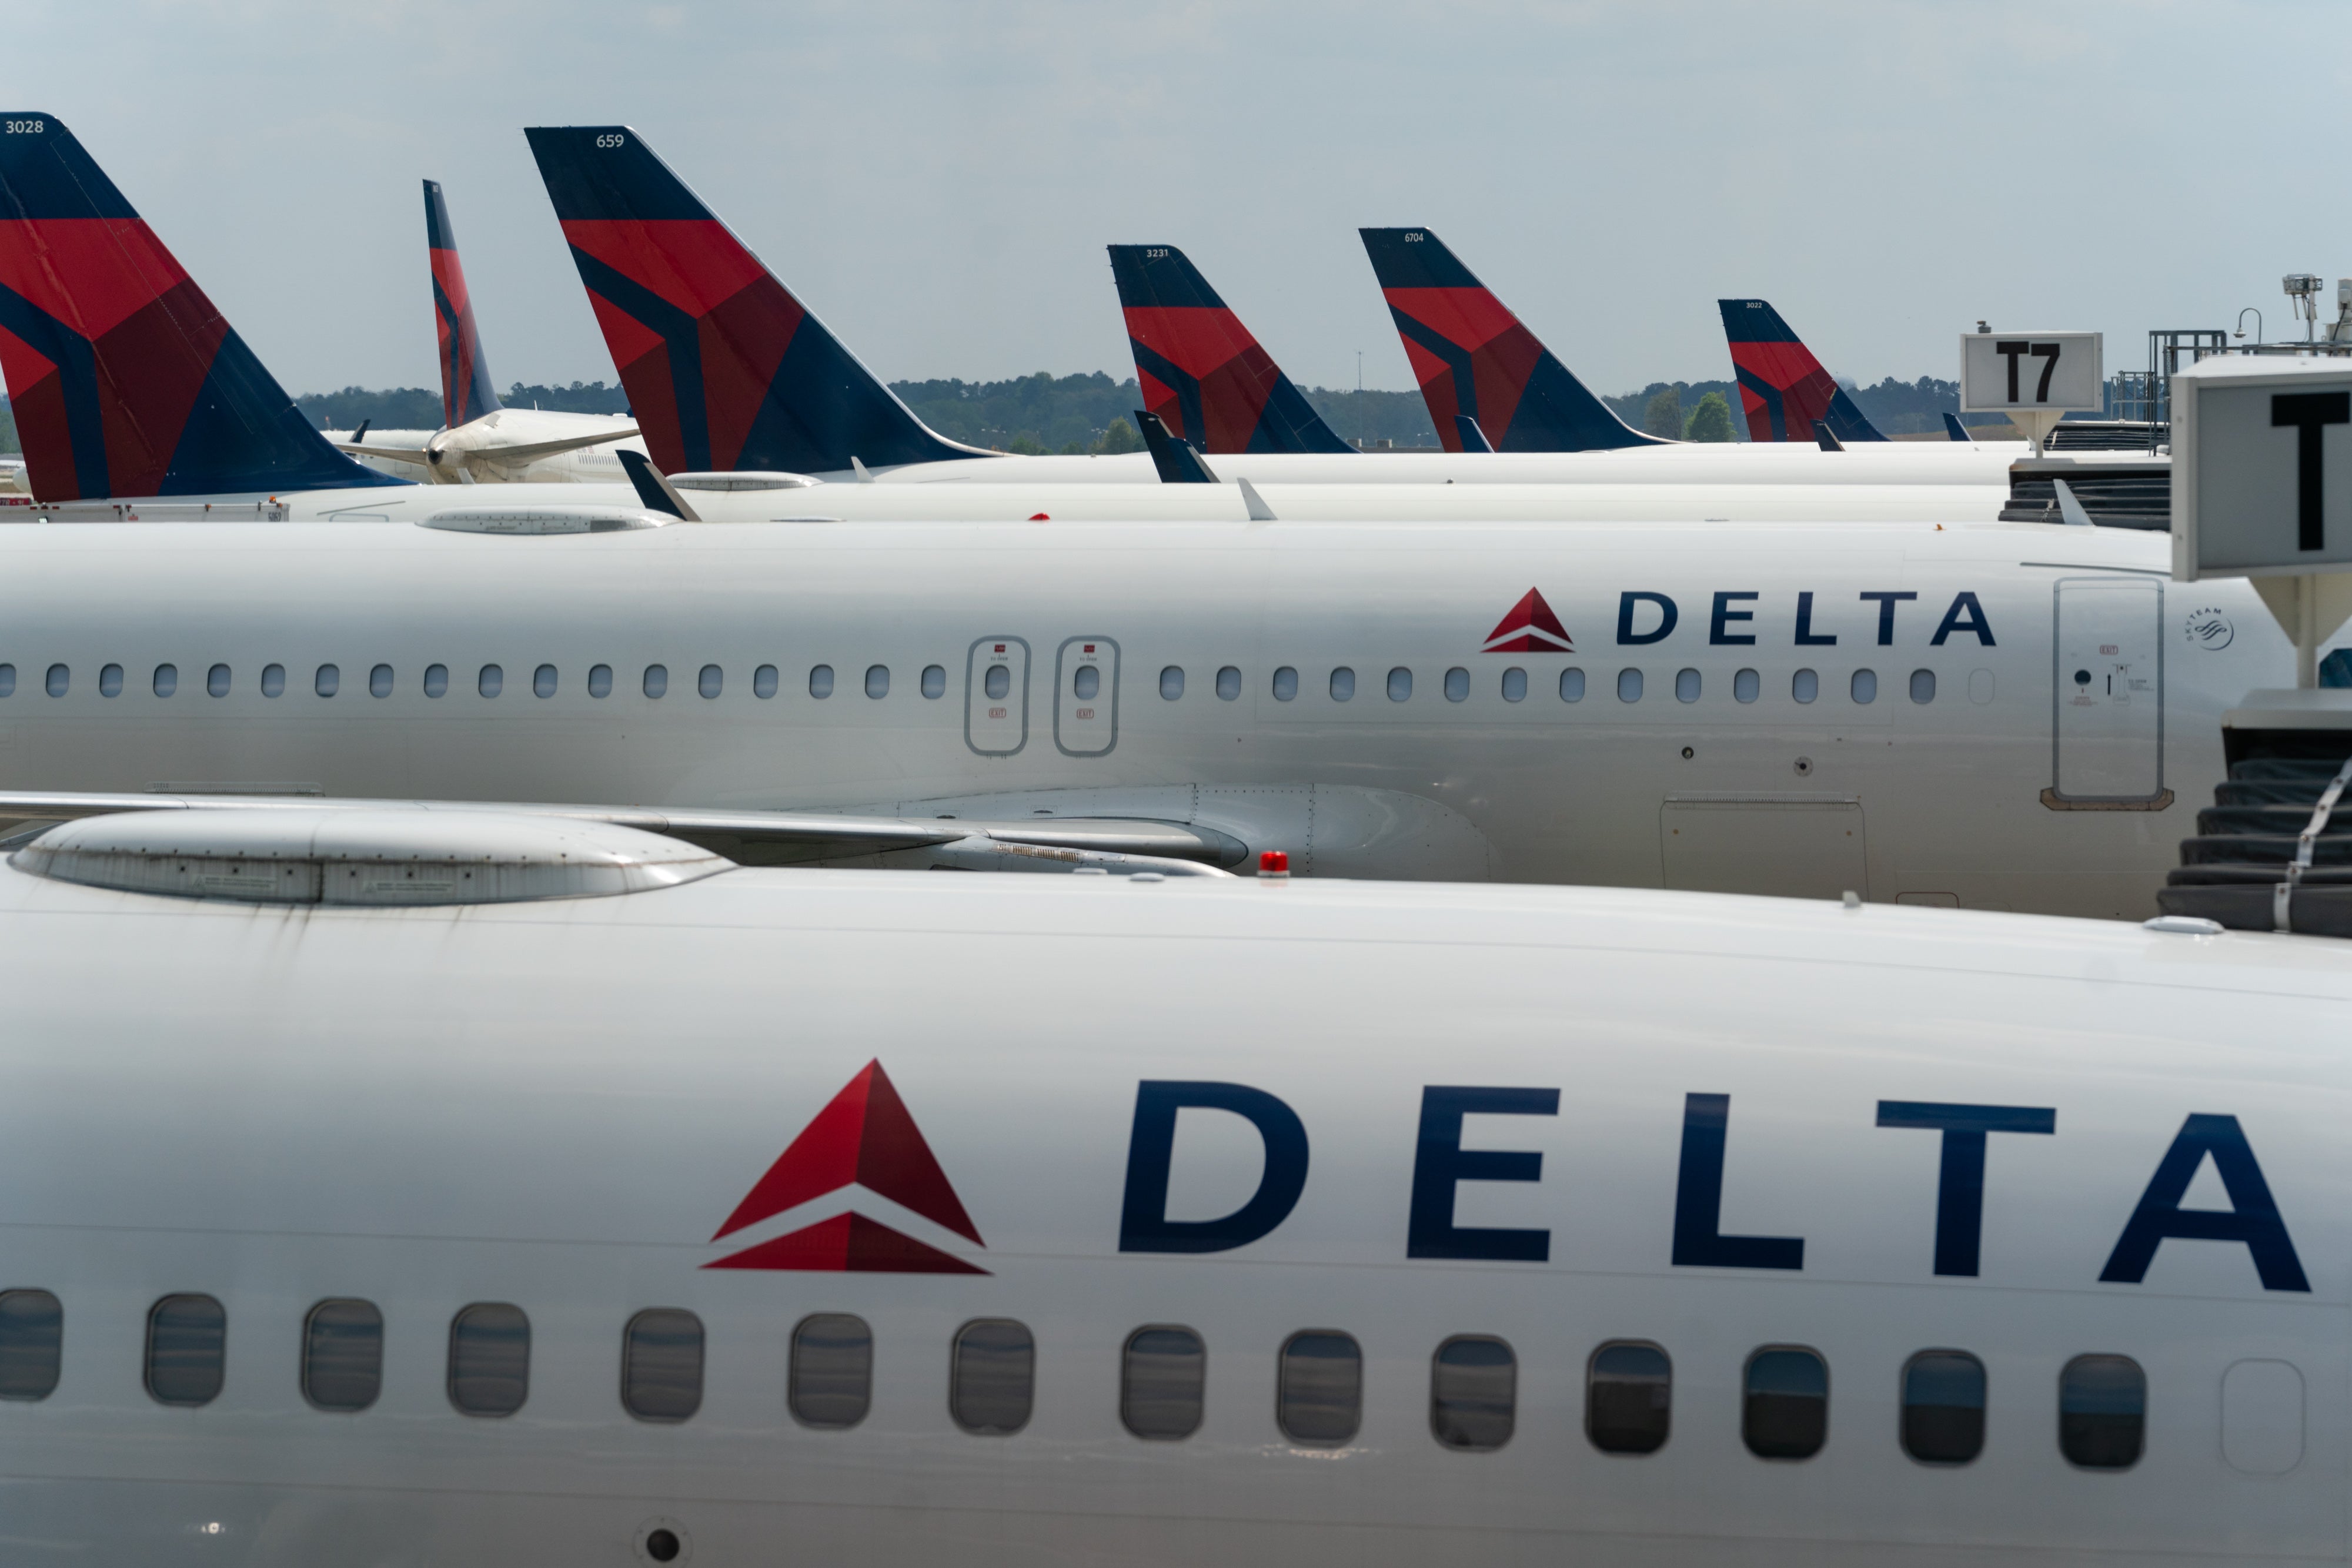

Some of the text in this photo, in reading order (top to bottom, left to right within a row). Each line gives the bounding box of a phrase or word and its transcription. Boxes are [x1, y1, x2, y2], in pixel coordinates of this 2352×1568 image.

[6, 120, 44, 133] 3028
[596, 134, 624, 148] 659
[1405, 232, 1424, 242] 6704
[1147, 249, 1168, 258] 3231
[1996, 341, 2060, 403] T7
[1616, 591, 1997, 647] DELTA
[2185, 607, 2222, 641] SKYTEAM
[990, 708, 1004, 717] EXIT
[1078, 709, 1093, 717] EXIT
[1118, 1081, 2313, 1293] DELTA
